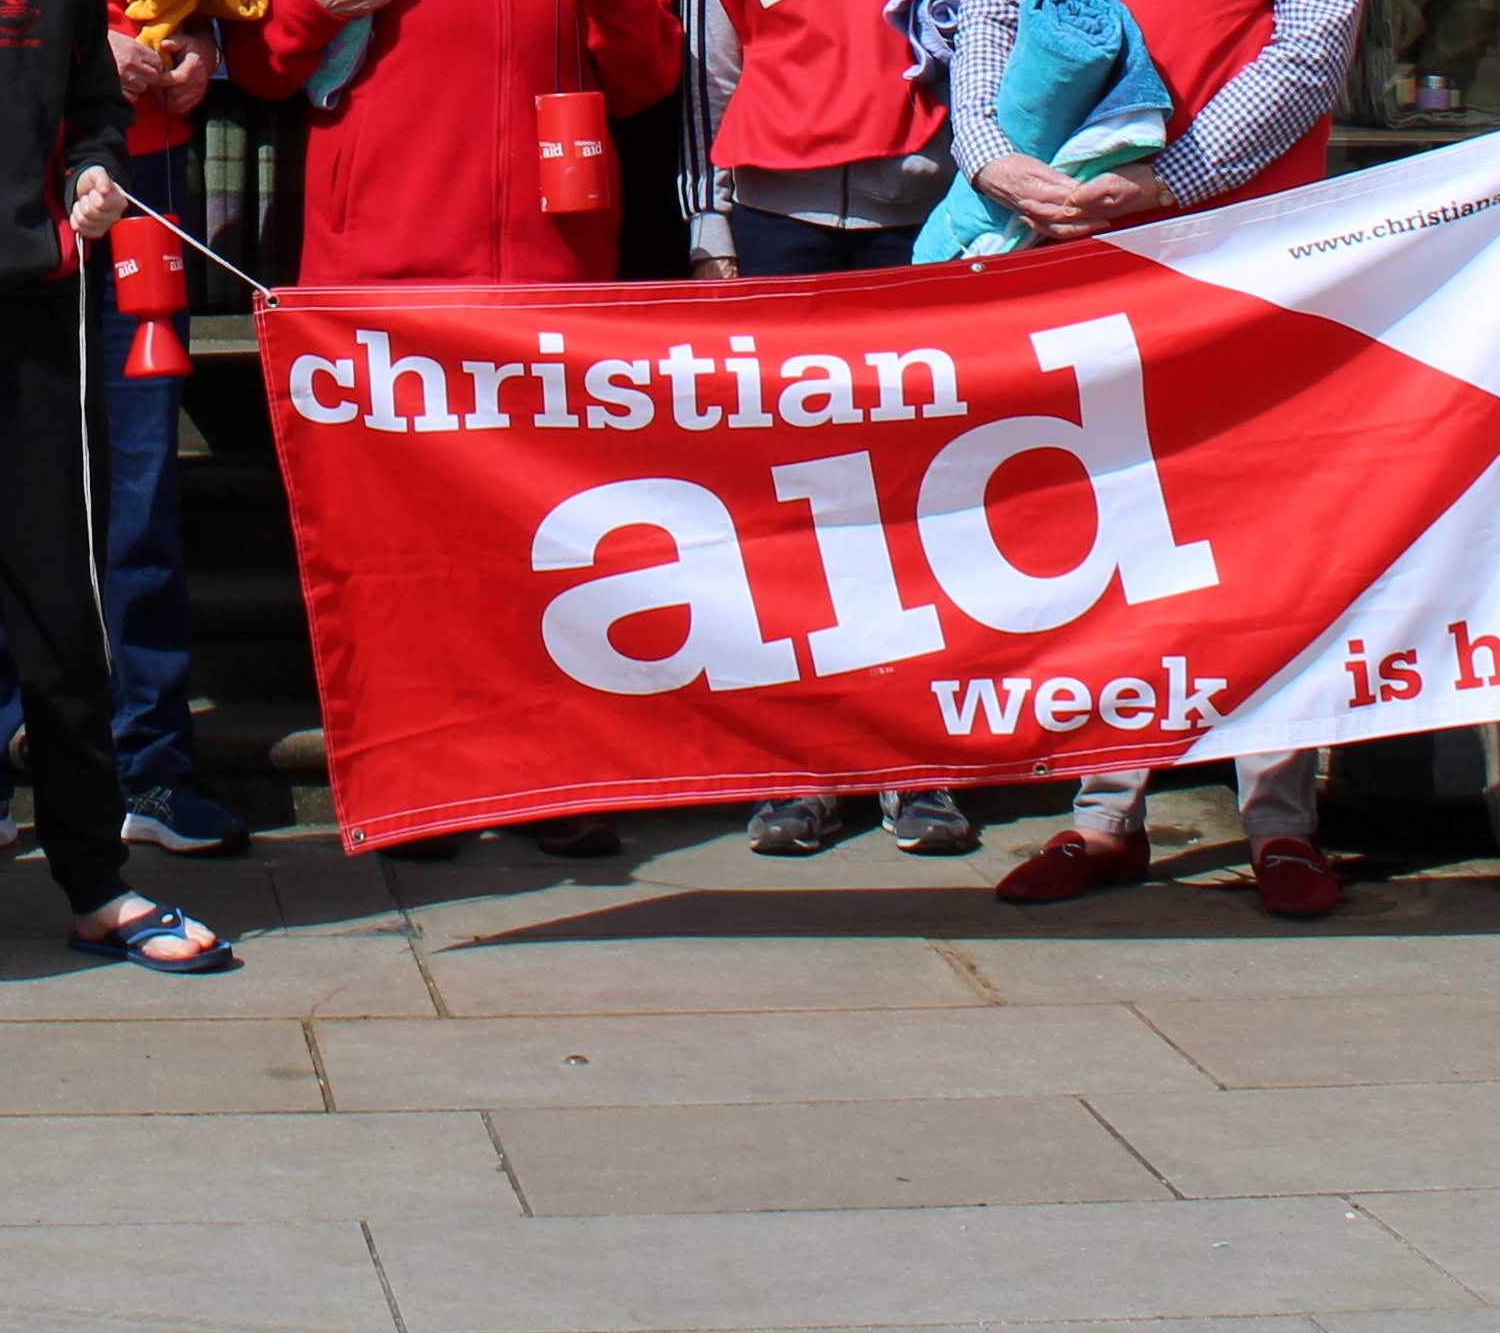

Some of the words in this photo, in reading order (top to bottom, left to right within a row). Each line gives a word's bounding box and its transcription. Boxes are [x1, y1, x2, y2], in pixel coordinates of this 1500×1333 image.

[288, 329, 968, 434] christian
[530, 311, 1221, 697] aid
[932, 655, 1230, 736] week
[1344, 638, 1424, 709] is
